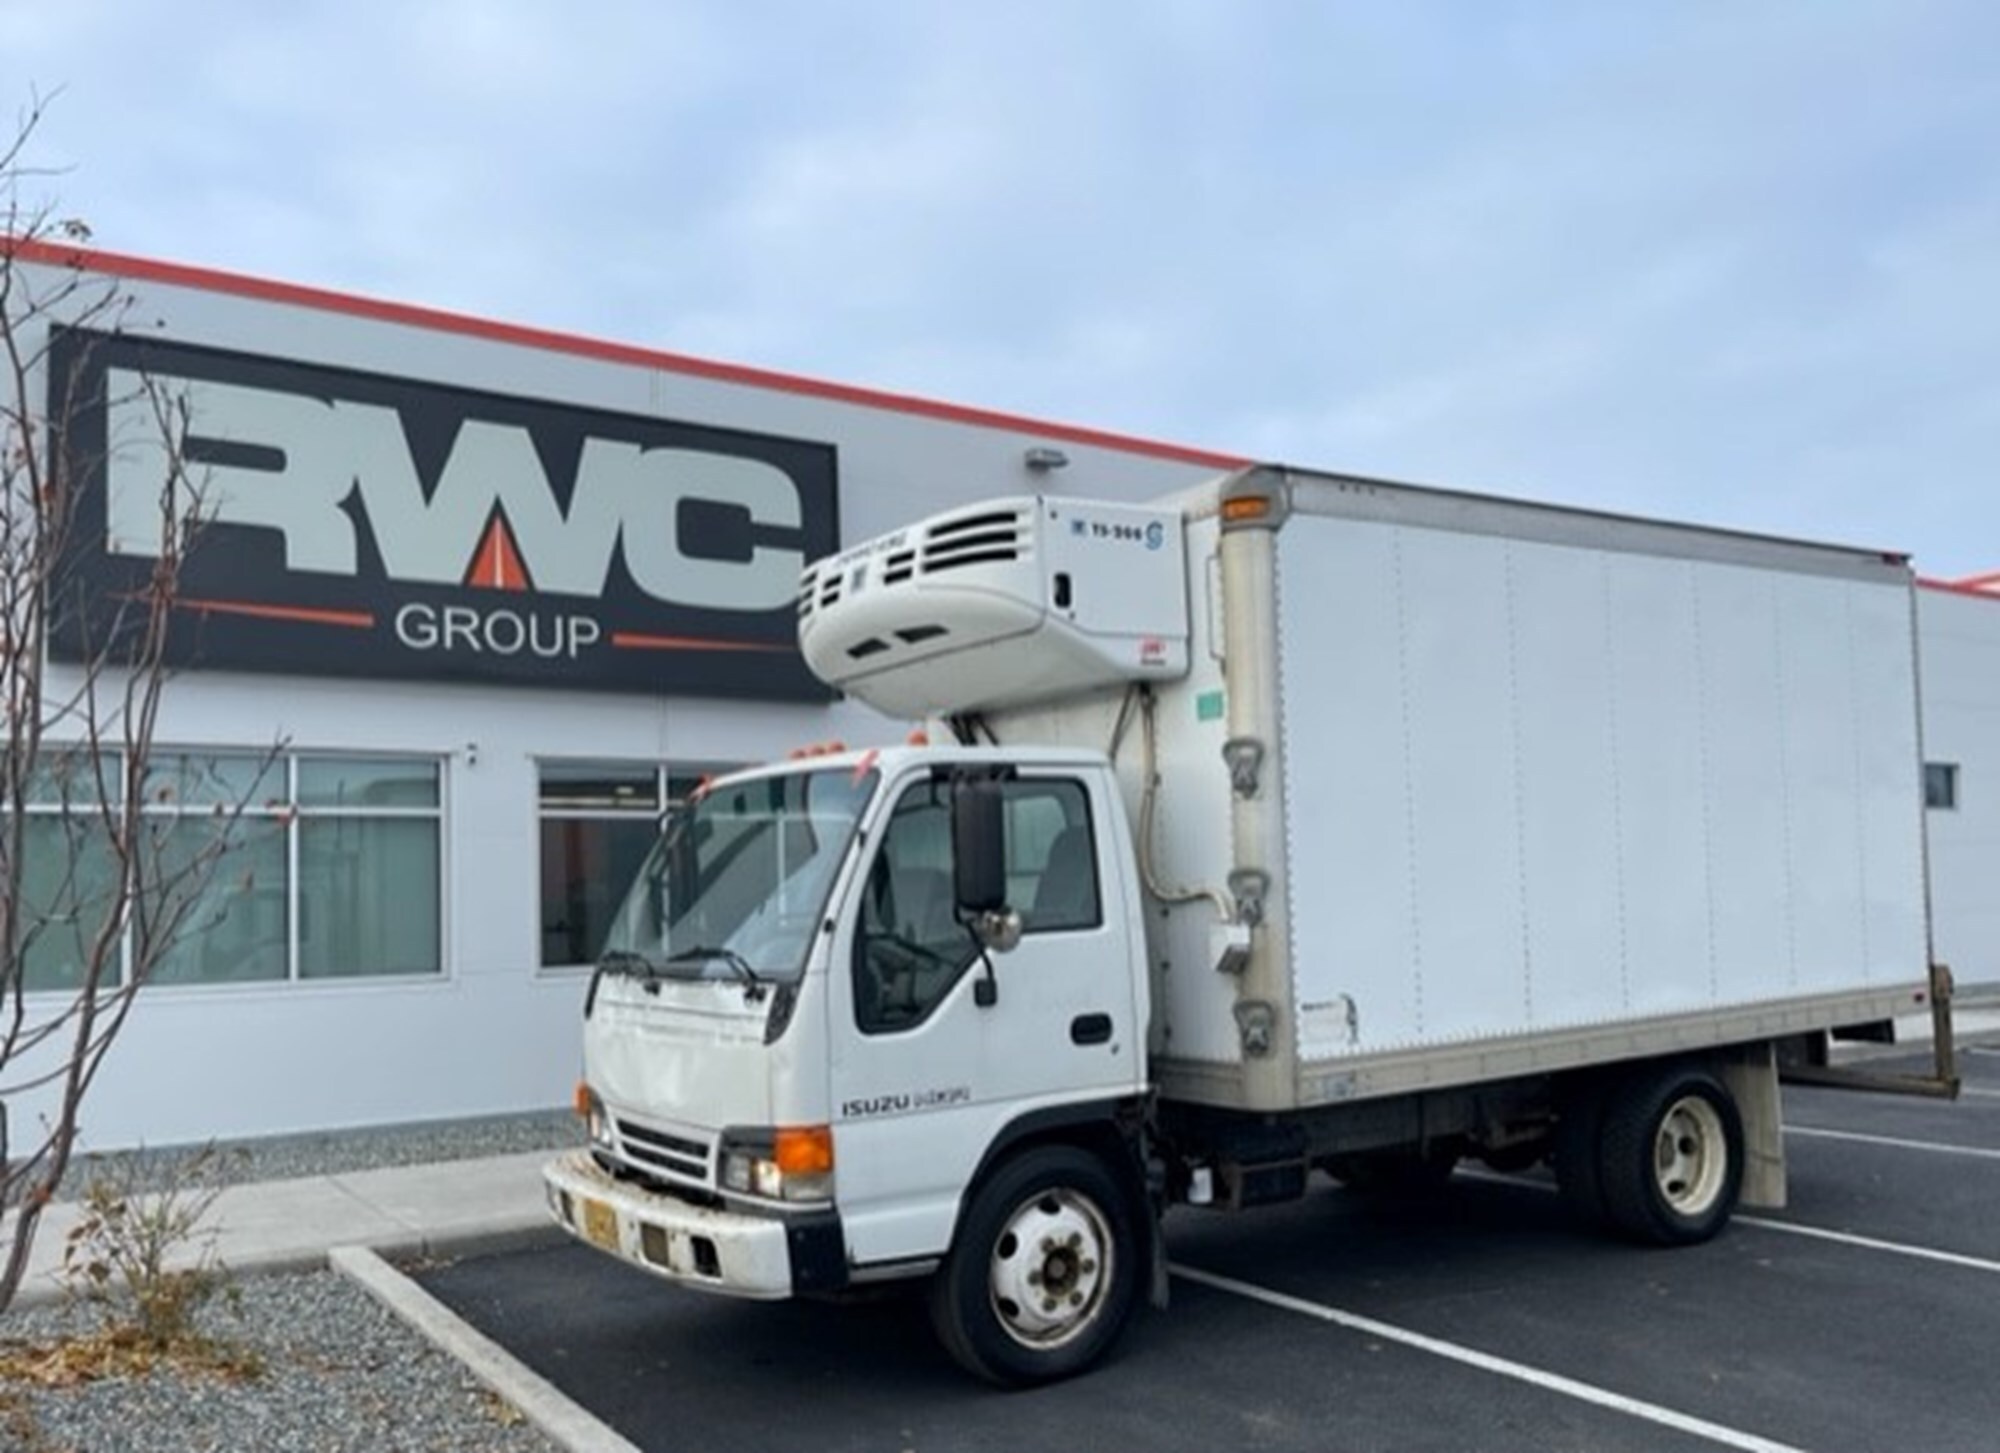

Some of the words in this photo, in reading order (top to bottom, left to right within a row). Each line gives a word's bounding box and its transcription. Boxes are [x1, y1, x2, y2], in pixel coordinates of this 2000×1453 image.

[106, 366, 805, 612] RWC
[395, 603, 600, 659] GROUP
[842, 1094, 910, 1118] ISUZU
